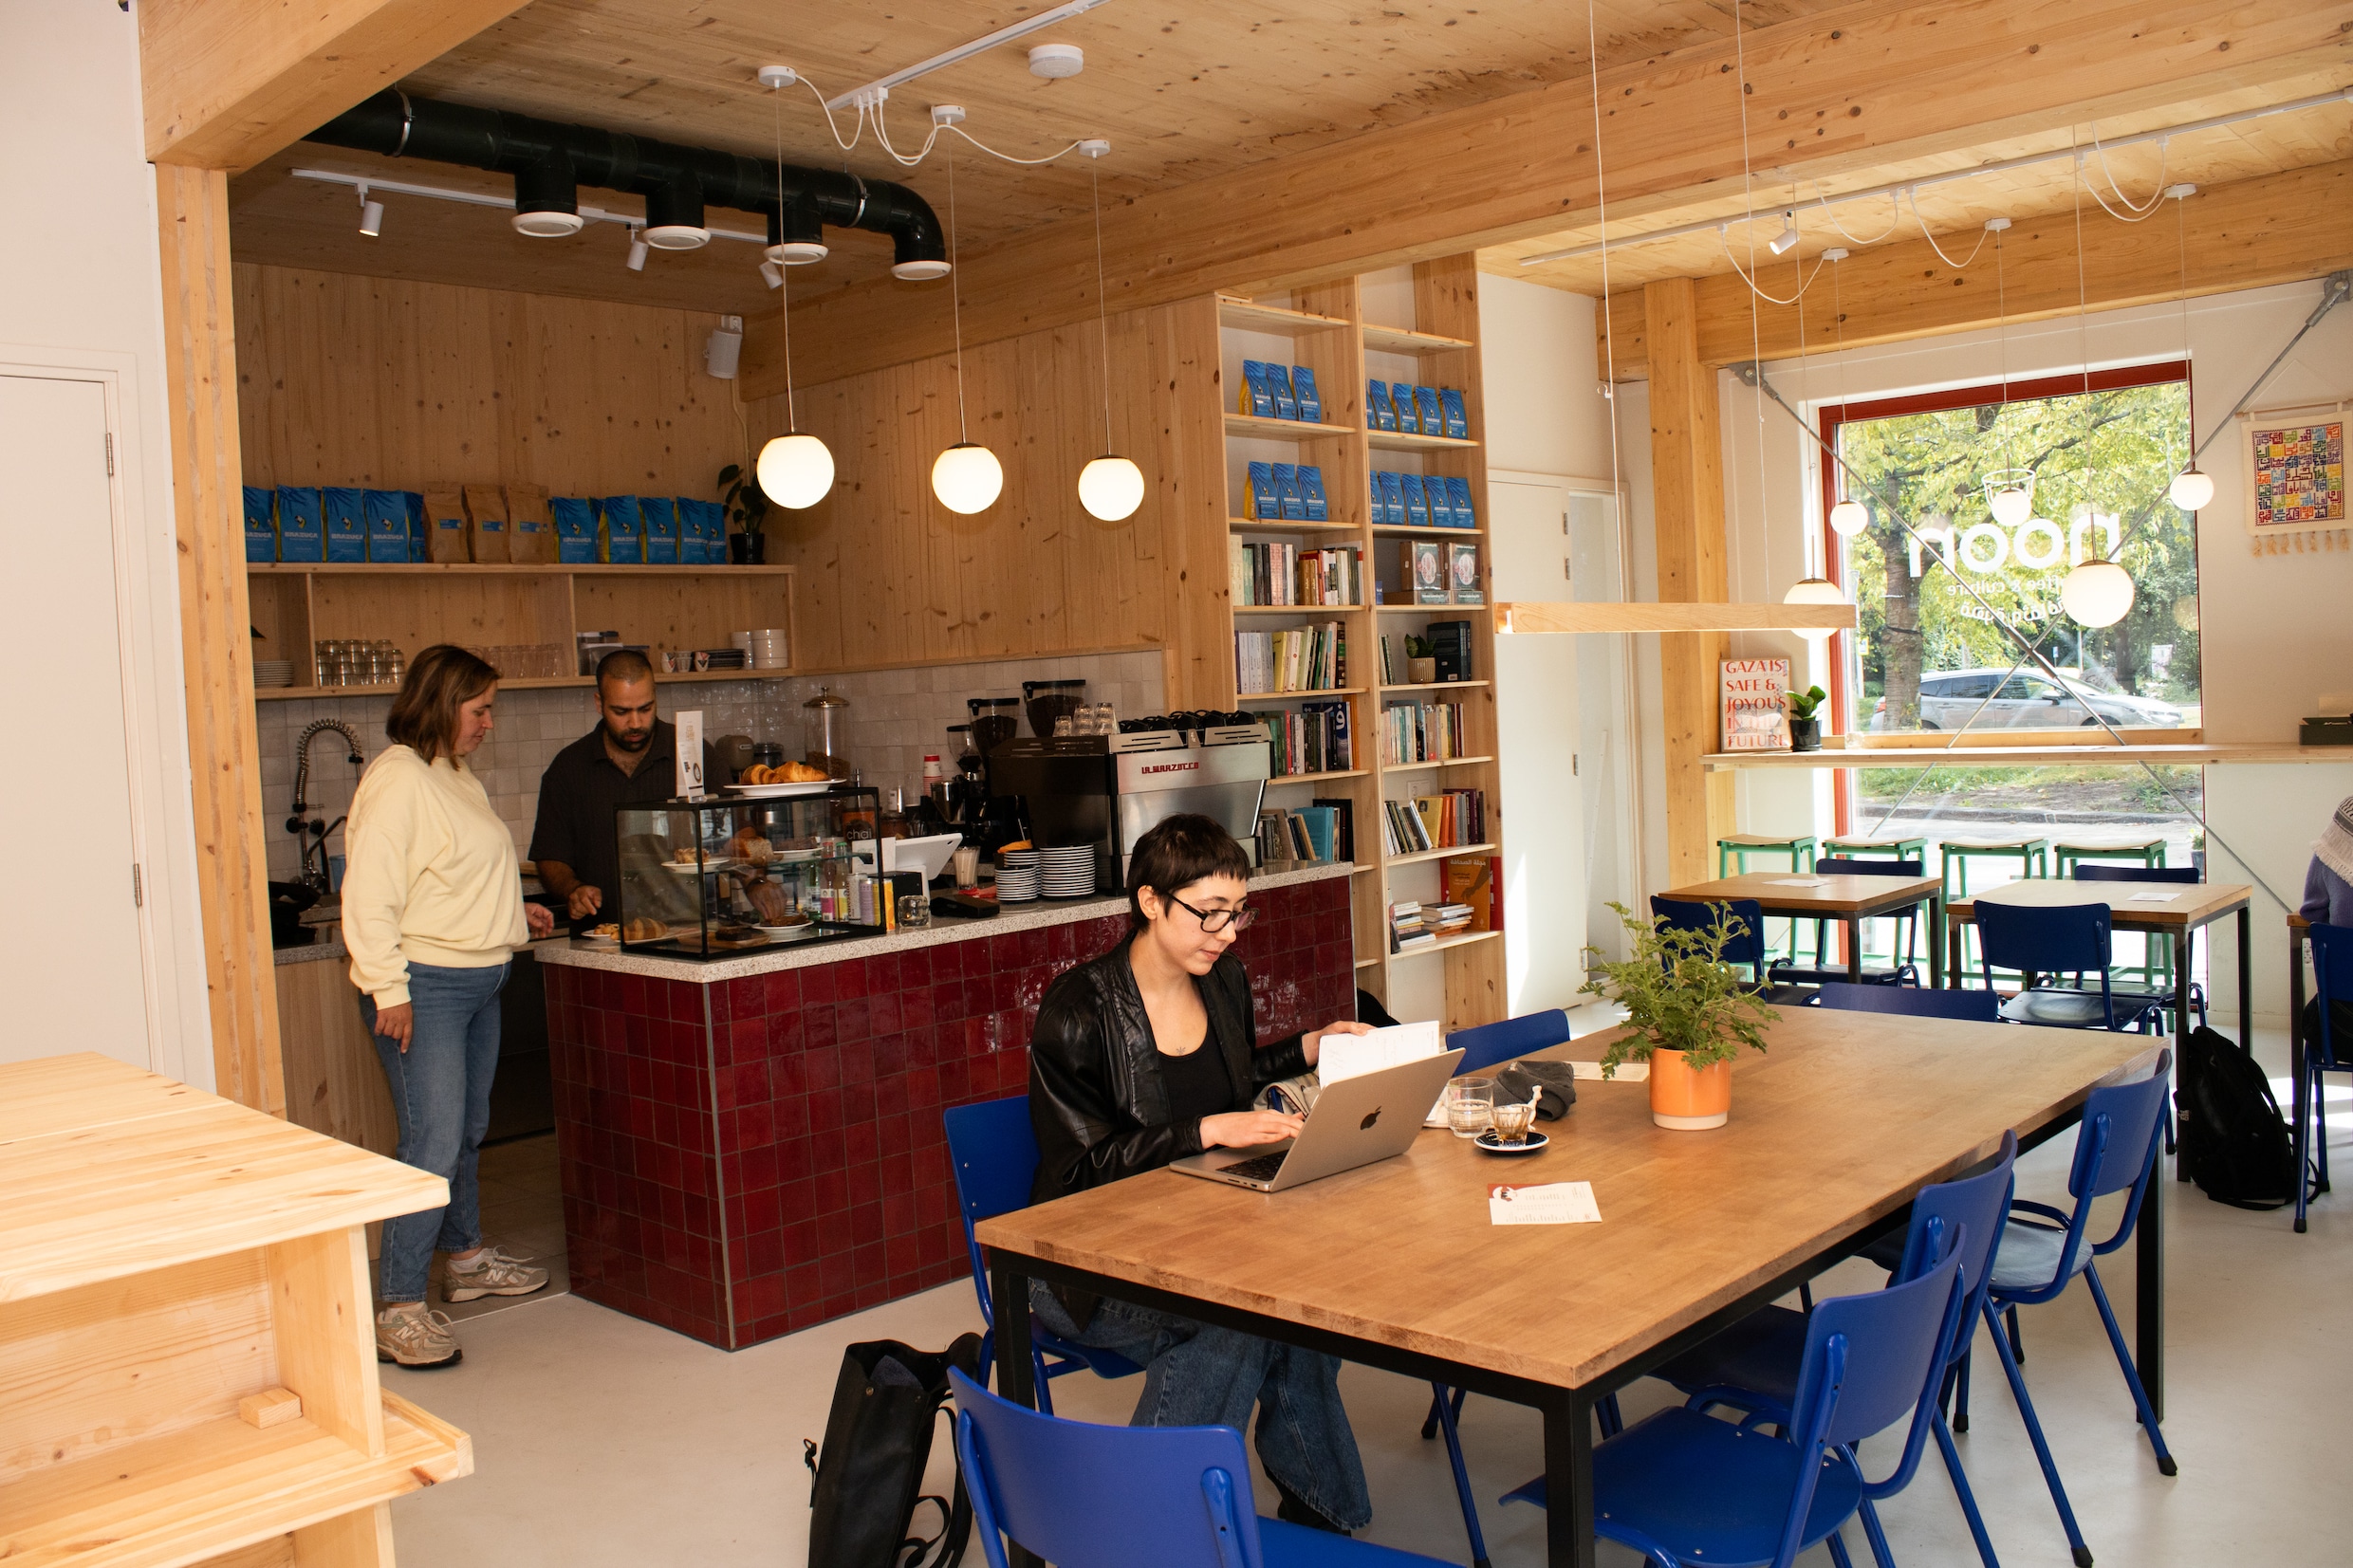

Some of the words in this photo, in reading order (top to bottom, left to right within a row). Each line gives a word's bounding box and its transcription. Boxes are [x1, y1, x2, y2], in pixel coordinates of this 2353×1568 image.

[1726, 660, 1767, 673] GAZA
[1769, 659, 1783, 673] IS
[1726, 679, 1762, 692] SAFE
[1766, 678, 1775, 691] &
[1727, 697, 1786, 713] JOYOUS
[1728, 734, 1788, 747] FUTURE
[846, 828, 872, 839] chai
